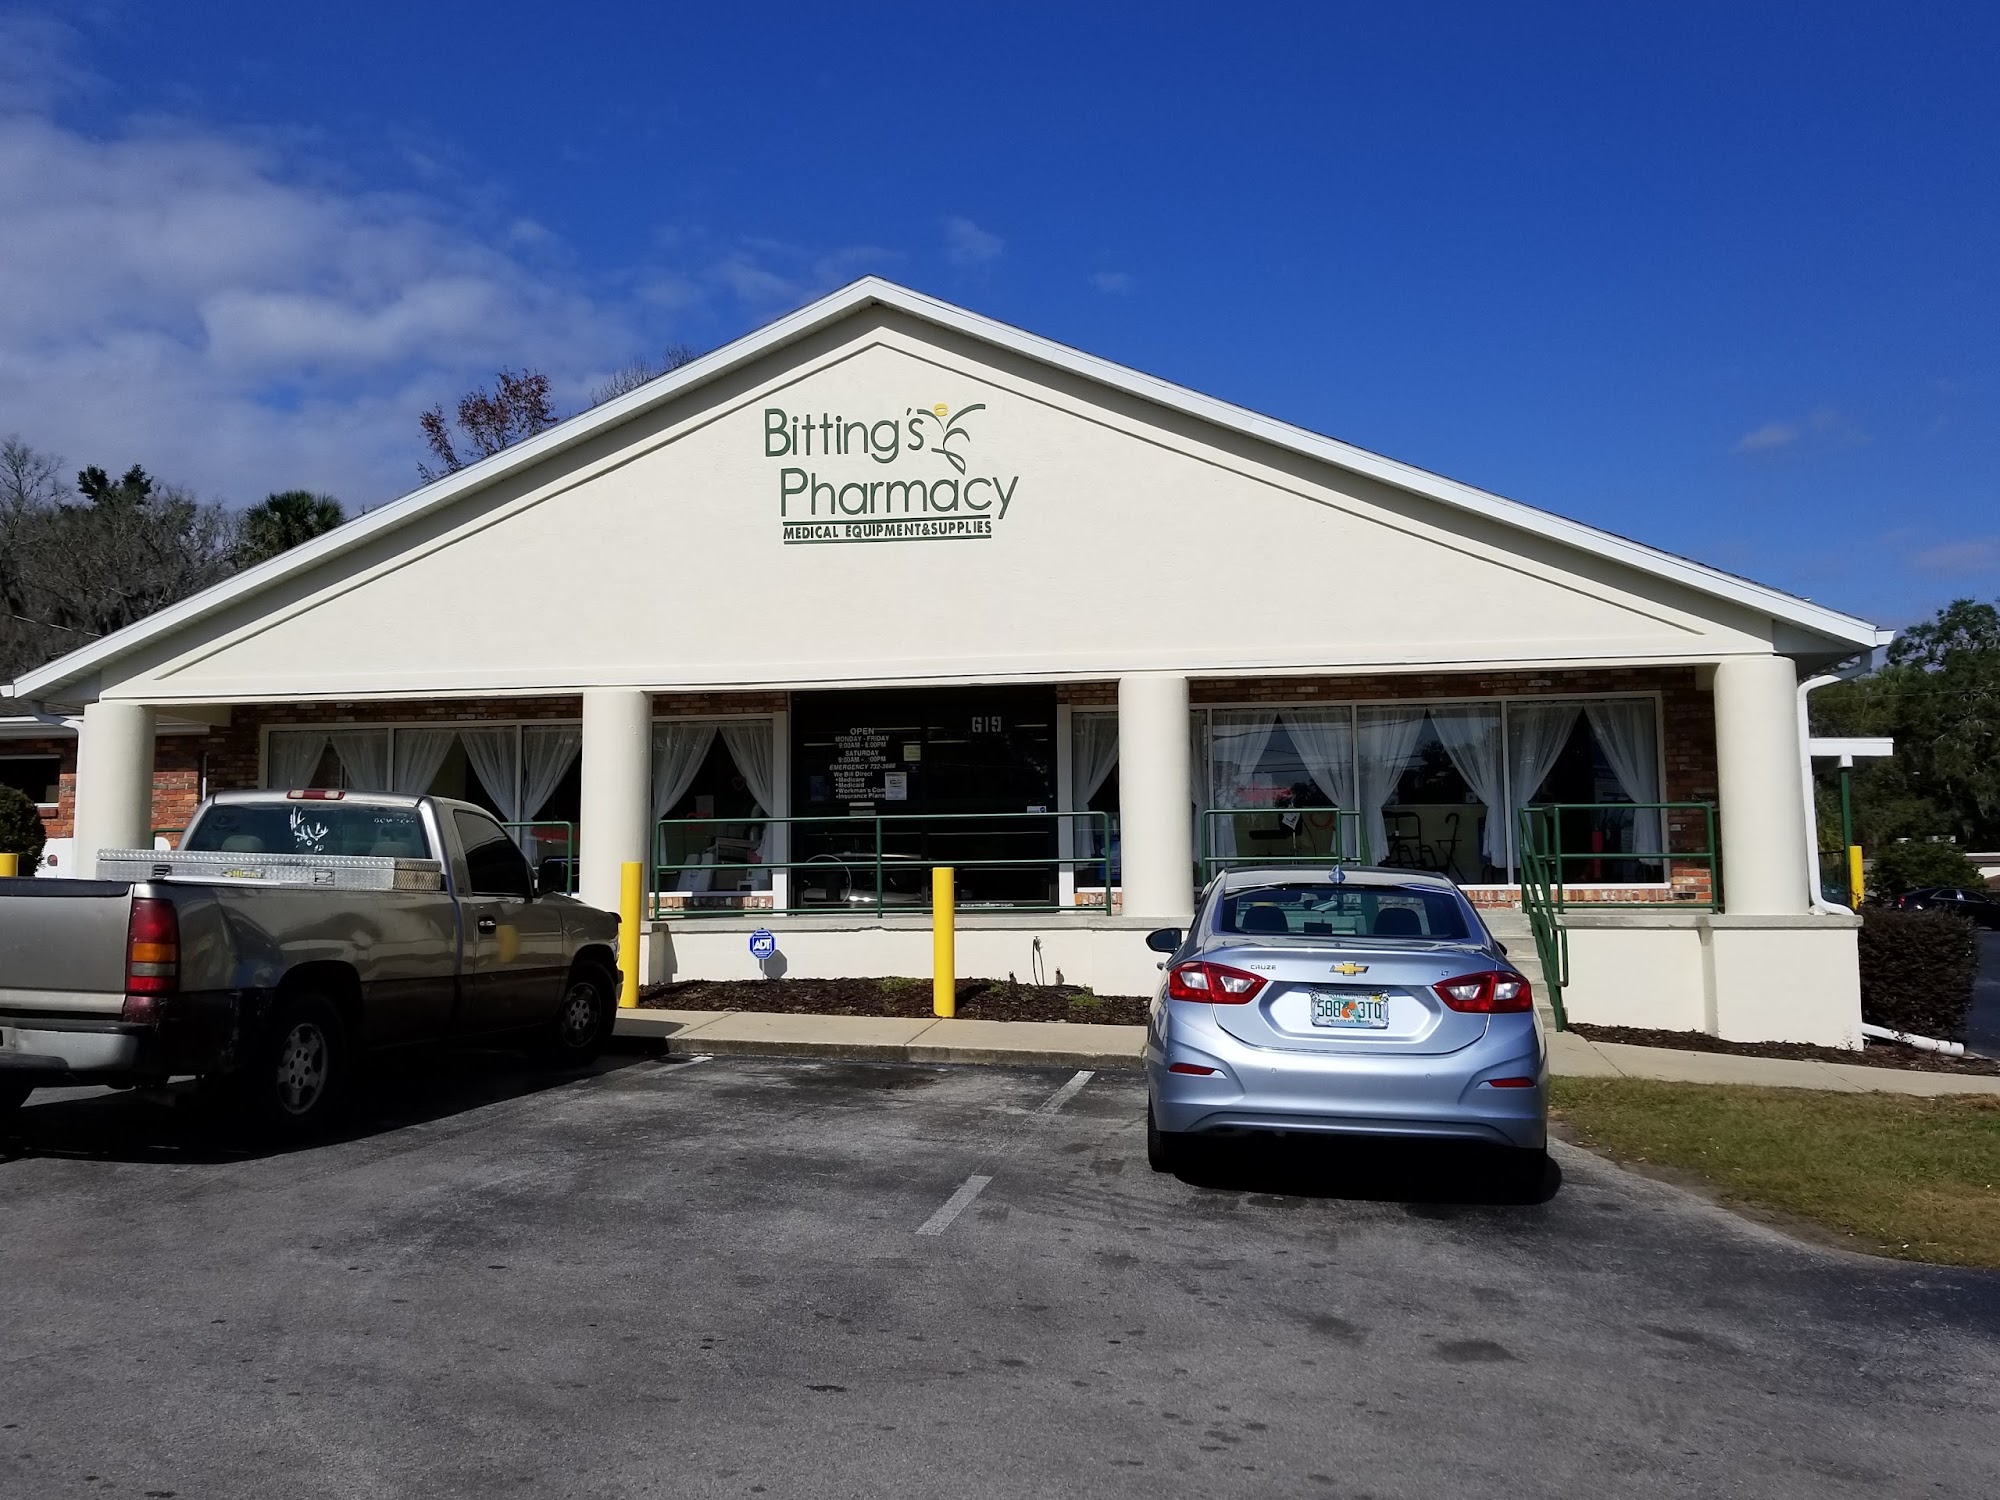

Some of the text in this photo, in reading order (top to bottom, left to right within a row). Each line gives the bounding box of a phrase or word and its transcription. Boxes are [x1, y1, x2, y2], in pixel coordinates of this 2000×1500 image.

[765, 407, 925, 464] Bitting's
[780, 467, 1019, 520] Pharmacy
[783, 520, 992, 540] MEDICAL EQUIPMENT&SUPPLIES
[753, 939, 771, 950] ADT
[1317, 1000, 1341, 1018] 588
